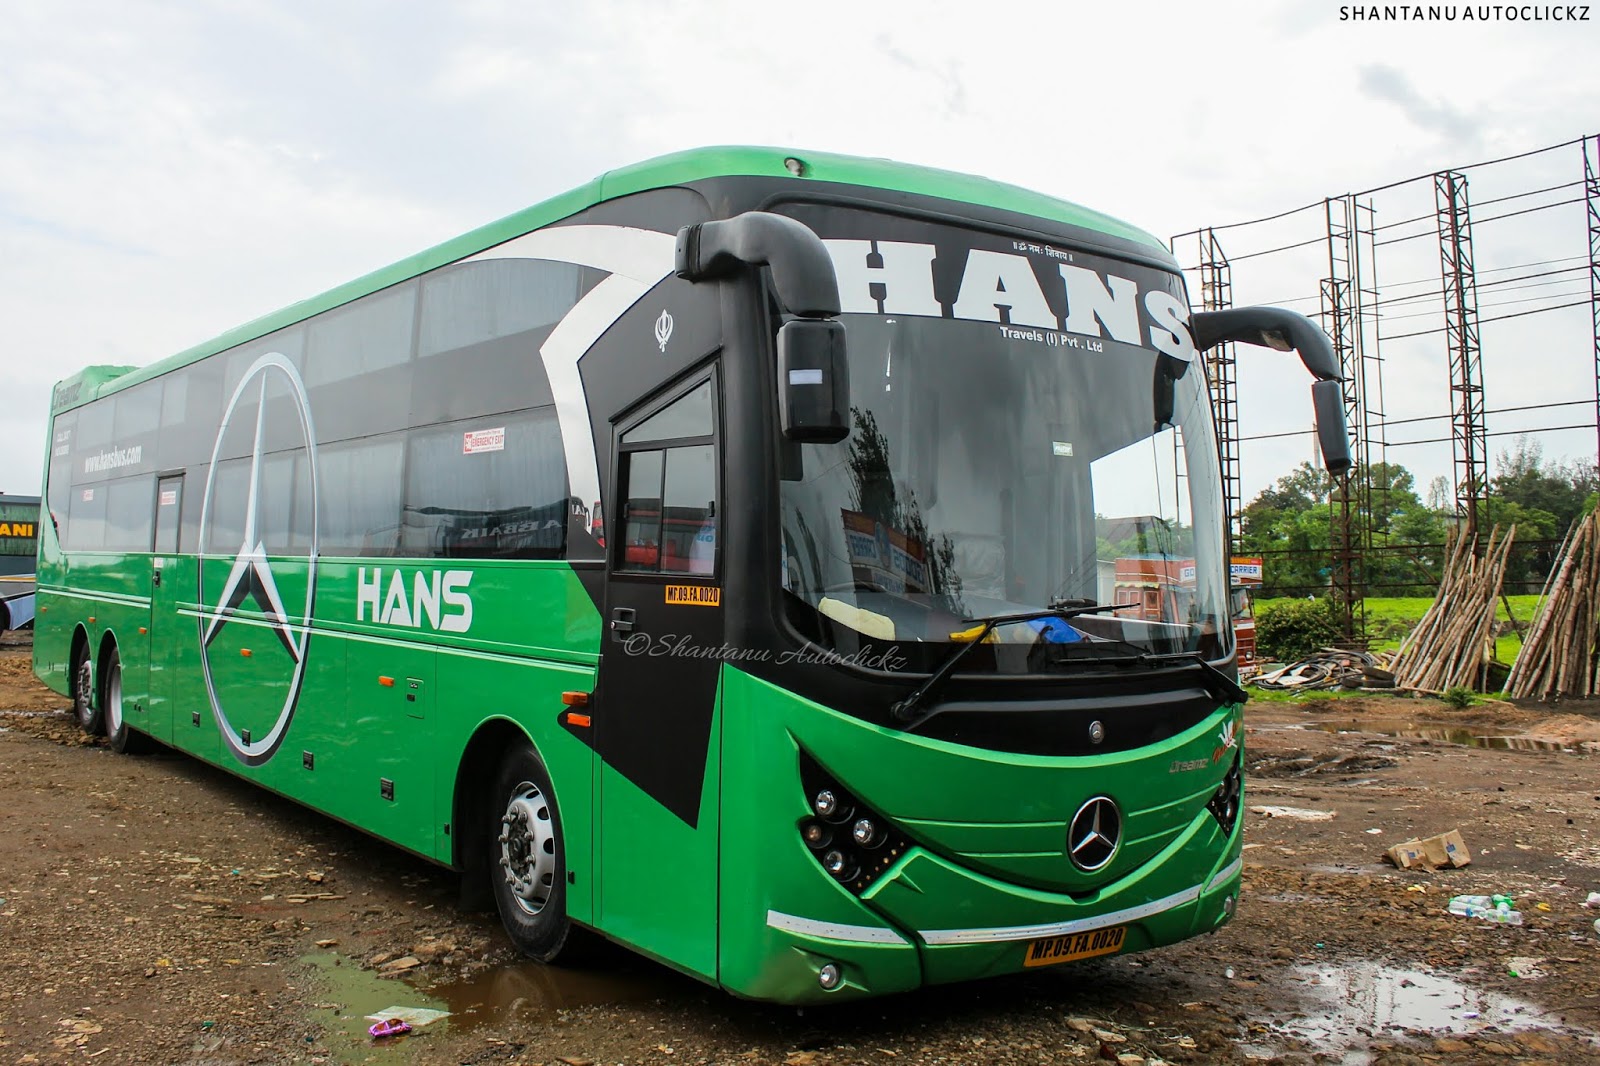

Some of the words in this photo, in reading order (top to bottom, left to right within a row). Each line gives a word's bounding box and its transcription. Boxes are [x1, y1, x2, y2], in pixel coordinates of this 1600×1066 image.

[821, 238, 1196, 363] HANS
[1000, 326, 1043, 342] Travels
[1086, 339, 1103, 353] Ltd
[471, 435, 494, 448] EMERGENCY
[84, 445, 142, 474] www.hansbus.com
[1230, 565, 1258, 574] CARRIER
[356, 566, 474, 634] HANS
[1169, 758, 1209, 774] Dreamz
[1030, 927, 1123, 960] MP.09.FA.0020
